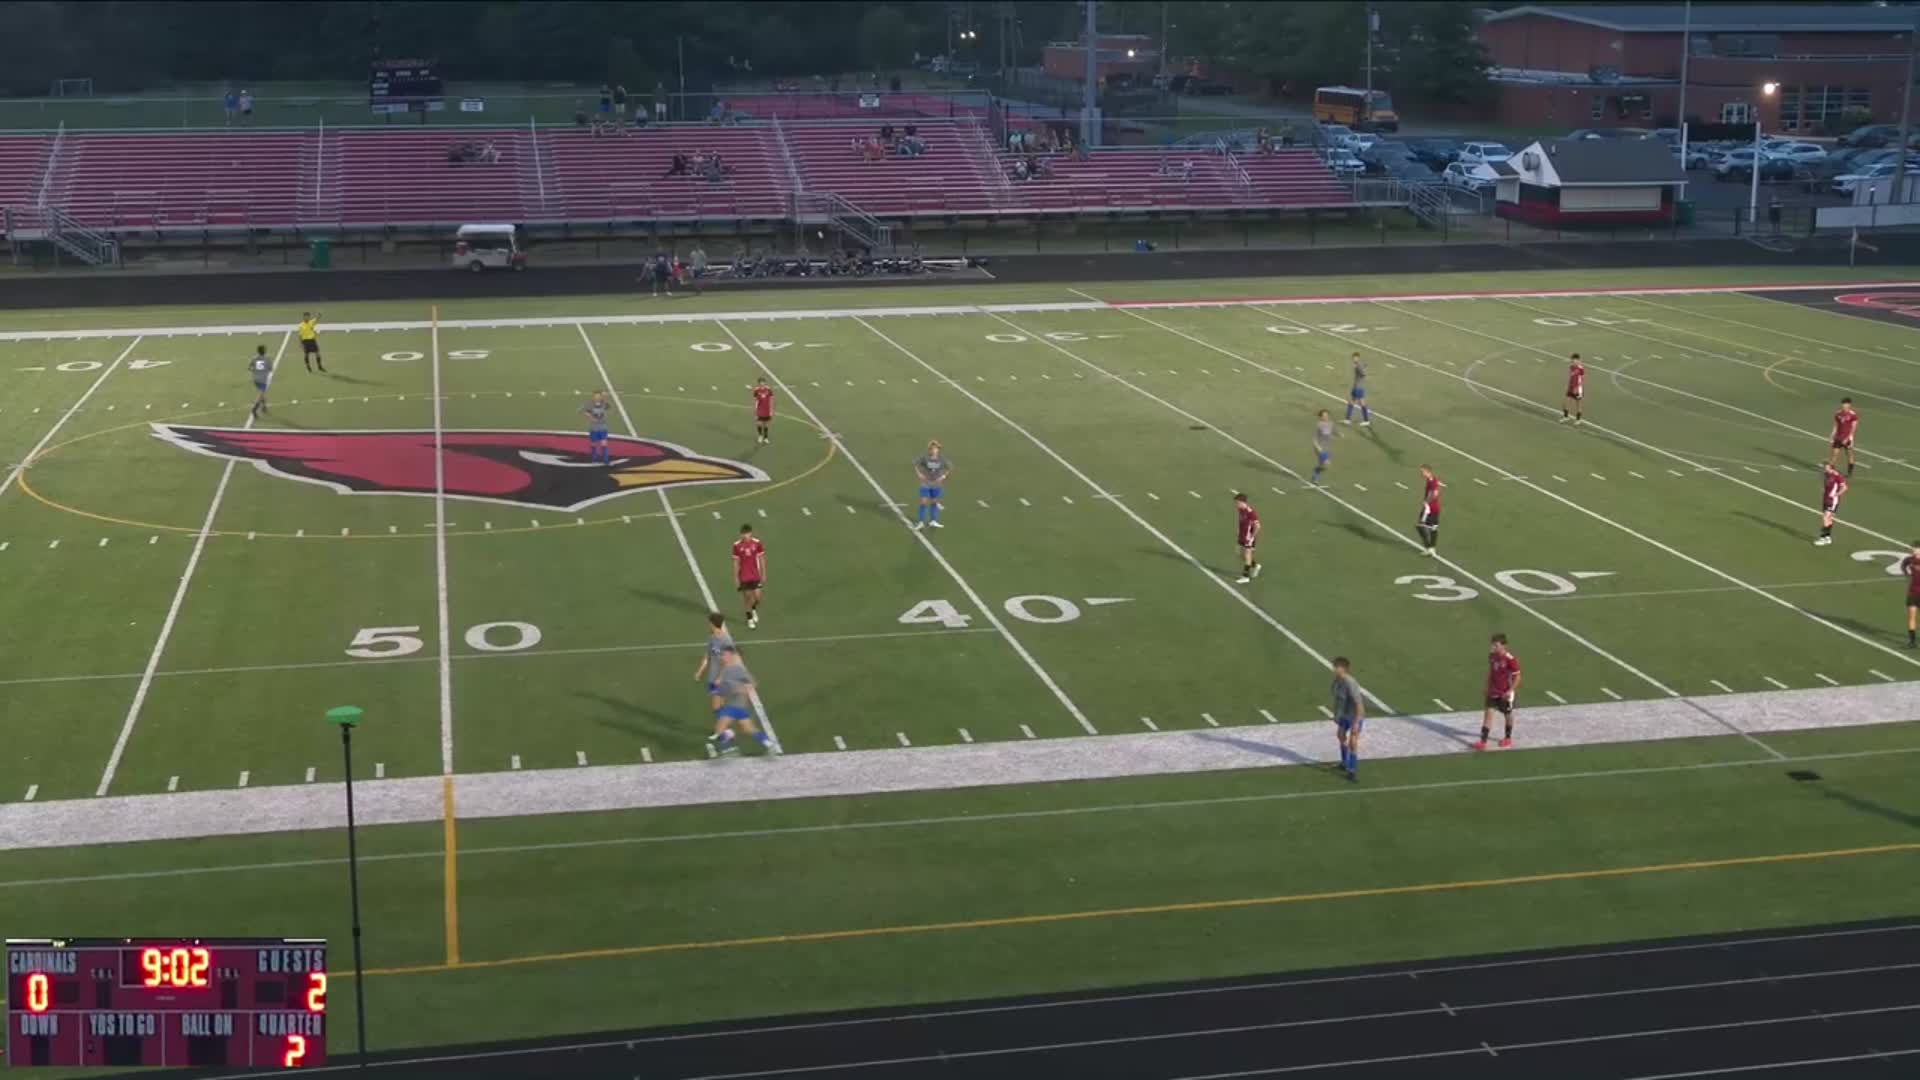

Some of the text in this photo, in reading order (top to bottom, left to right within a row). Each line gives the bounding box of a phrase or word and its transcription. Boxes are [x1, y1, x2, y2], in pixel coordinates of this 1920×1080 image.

[1394, 568, 1577, 602] 30
[897, 595, 1083, 628] 40
[345, 621, 542, 658] 50
